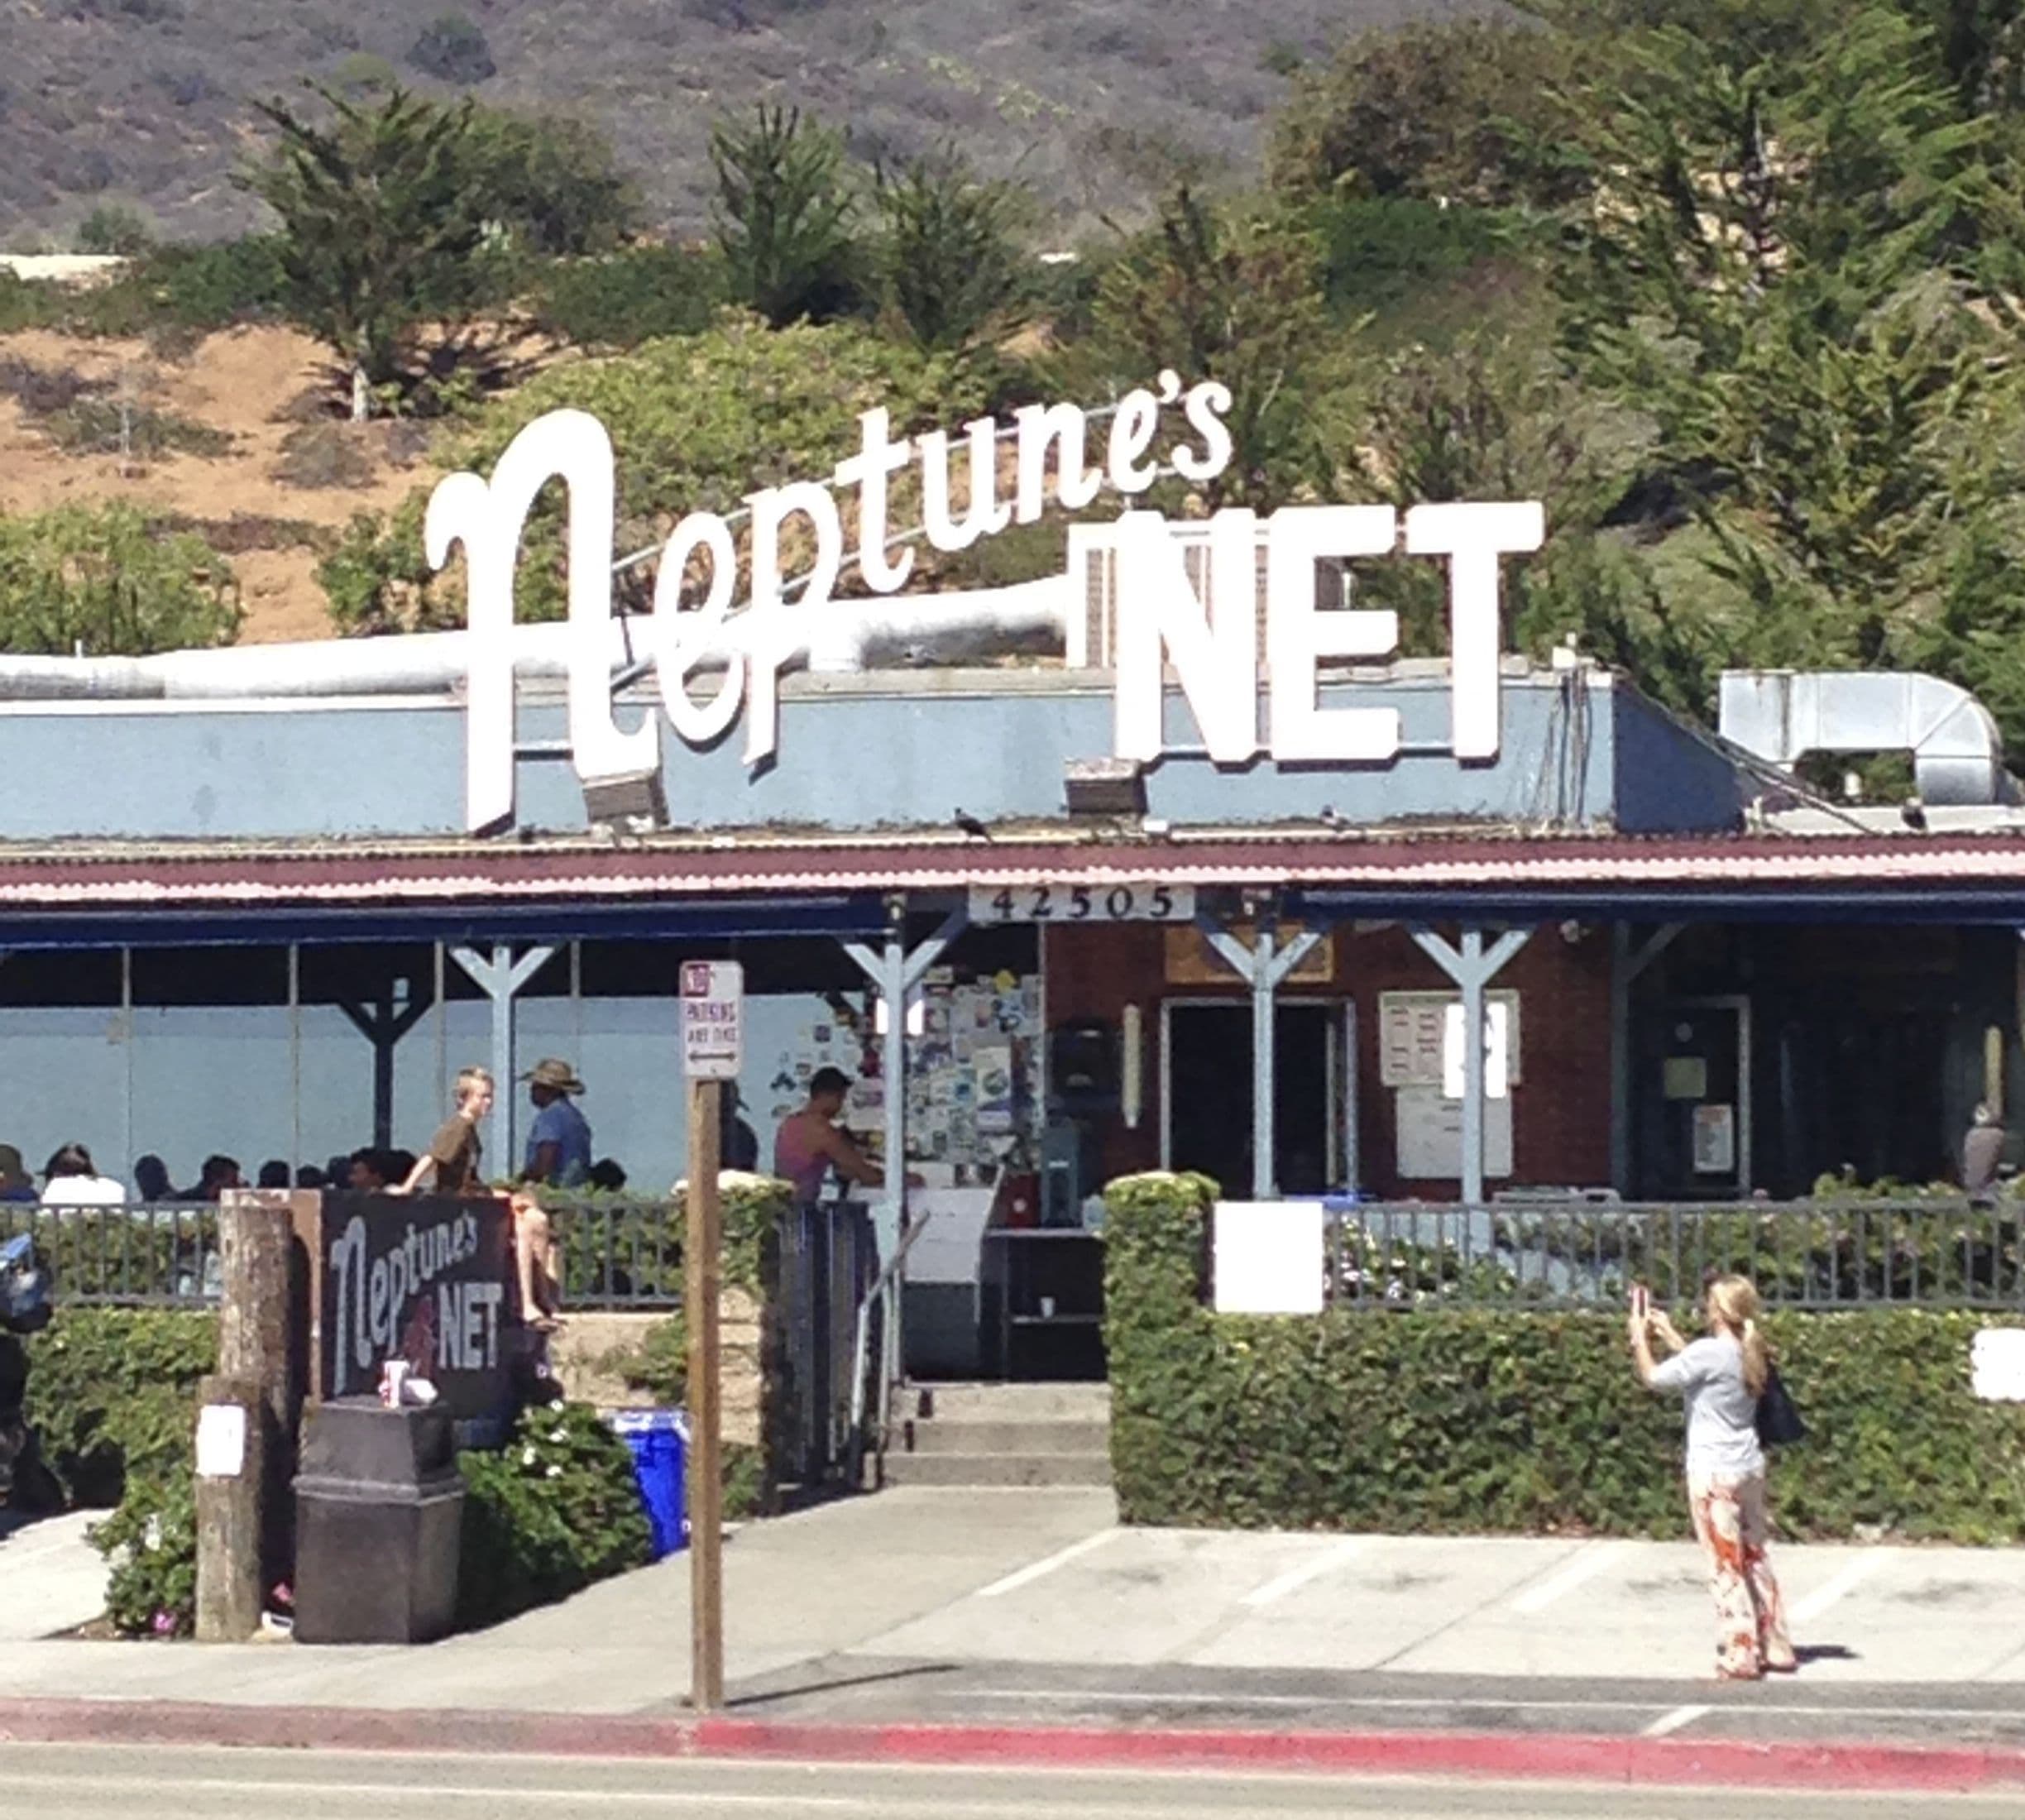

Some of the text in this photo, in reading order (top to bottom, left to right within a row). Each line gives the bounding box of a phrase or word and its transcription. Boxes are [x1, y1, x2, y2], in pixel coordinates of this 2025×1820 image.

[424, 369, 1233, 828] Neptune's
[1114, 501, 1545, 762] NET
[991, 885, 1174, 920] 42505
[330, 1209, 478, 1396] Neptune's
[438, 1282, 503, 1369] NET
